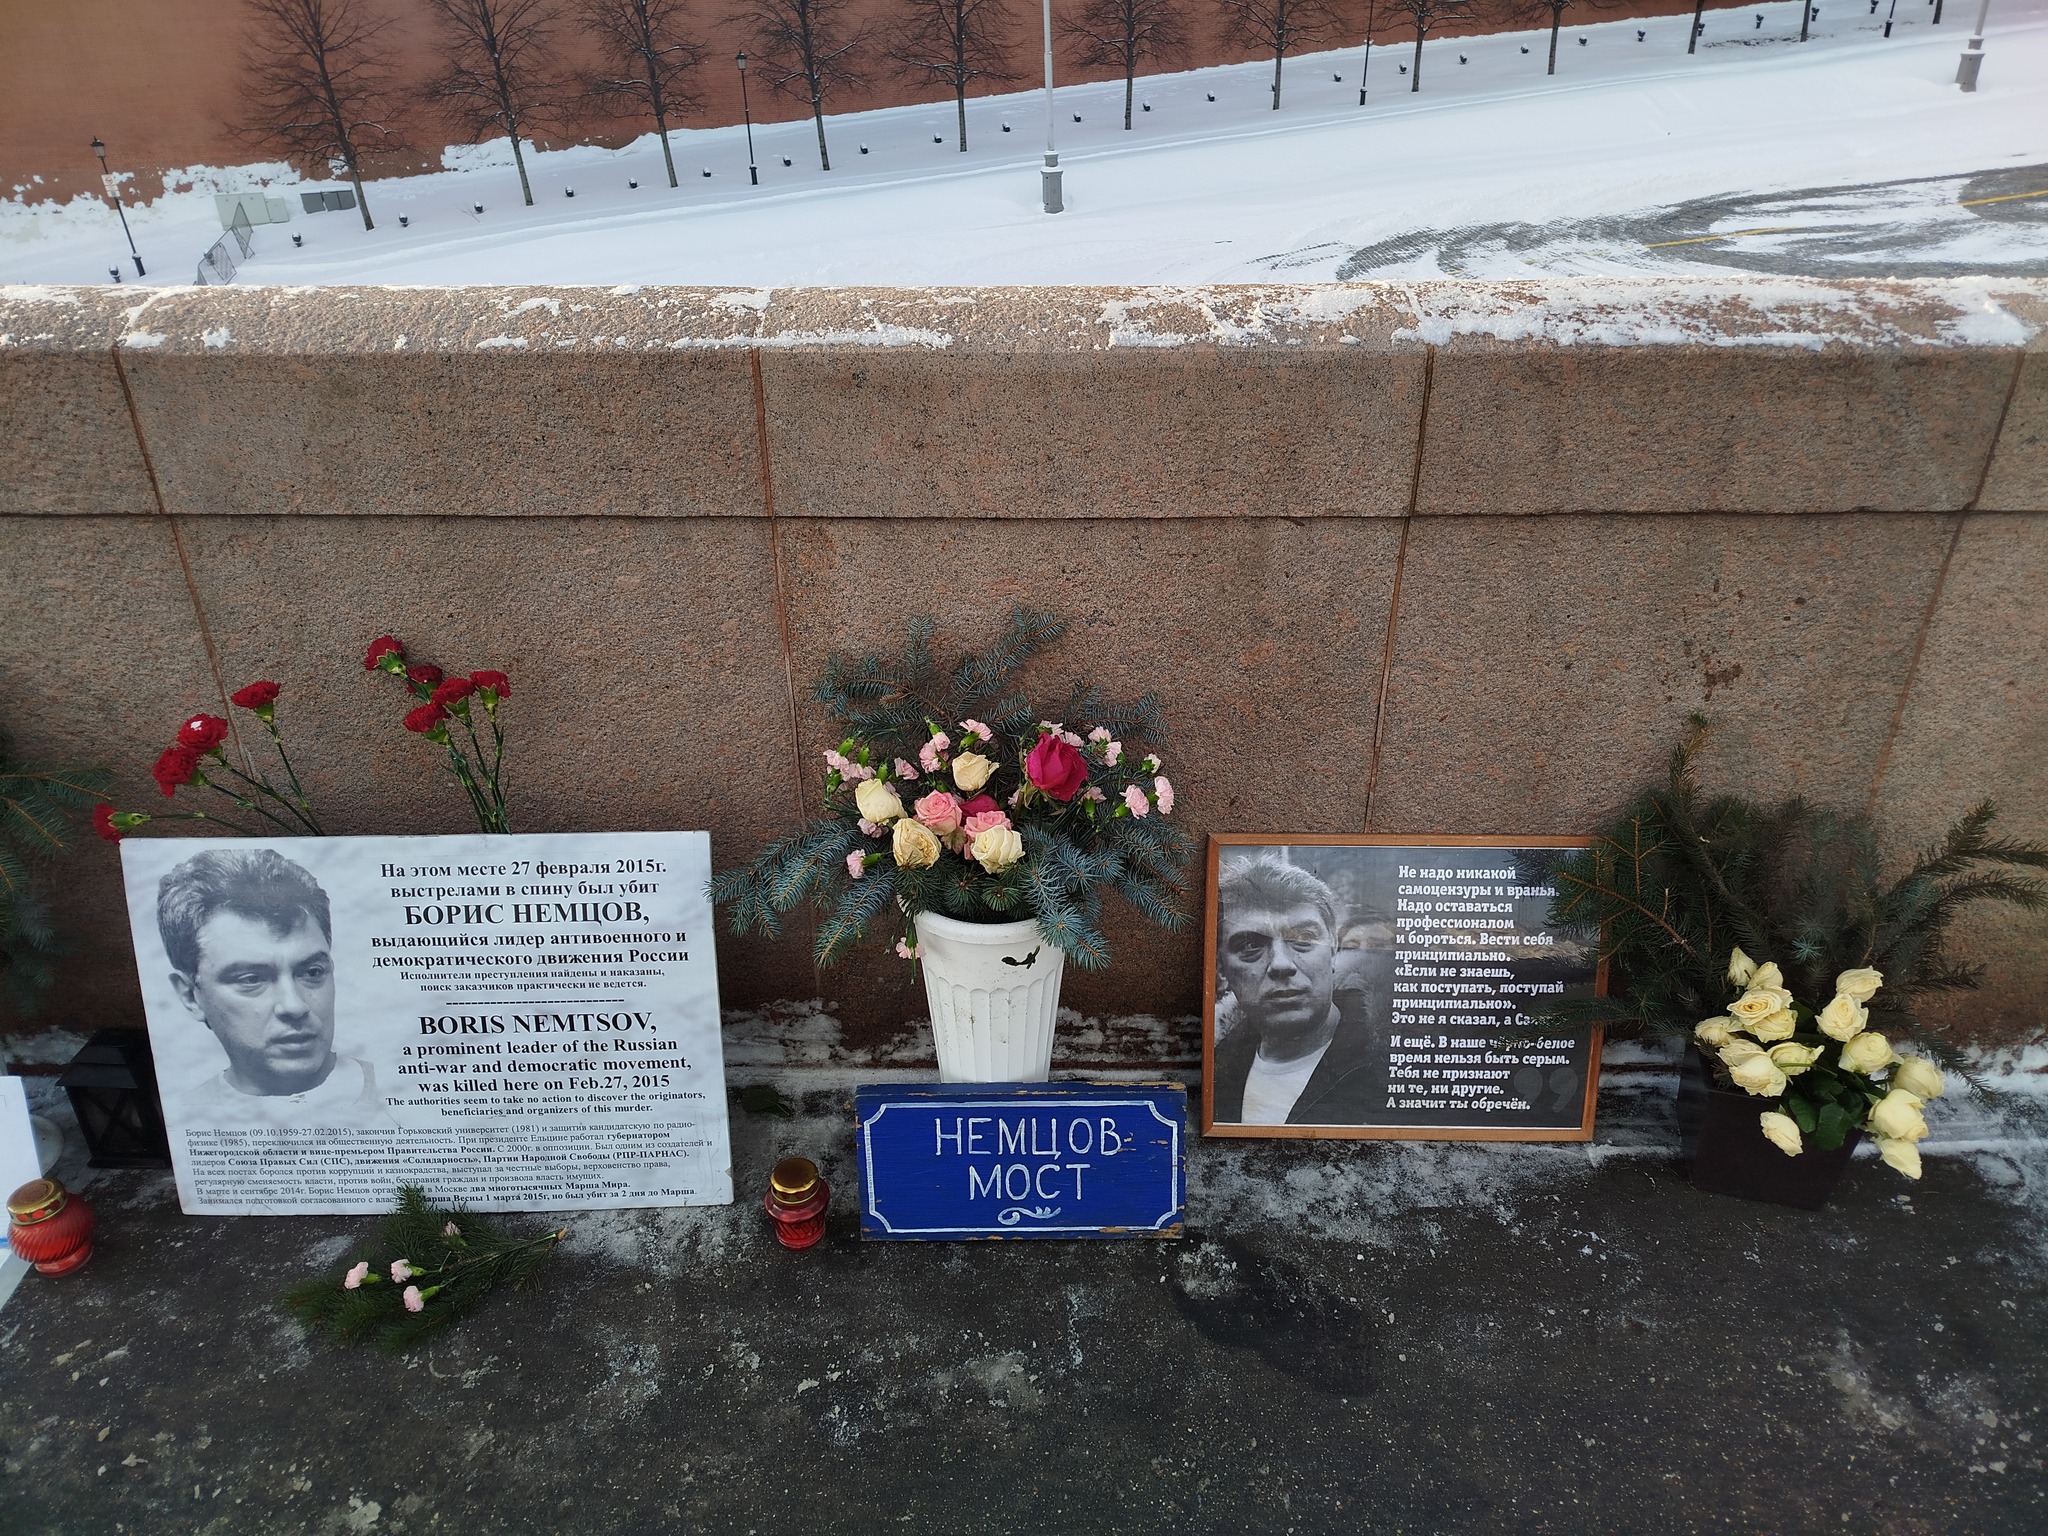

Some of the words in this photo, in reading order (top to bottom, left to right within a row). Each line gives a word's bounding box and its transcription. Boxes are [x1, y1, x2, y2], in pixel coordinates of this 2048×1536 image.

[381, 864, 406, 877] На
[411, 867, 451, 877] этом
[458, 865, 506, 876] месте
[511, 861, 530, 875] 27
[536, 861, 610, 878] февраля
[616, 859, 666, 873] 2015г.
[1398, 865, 1416, 878] Не
[1419, 869, 1453, 881] надо
[1456, 866, 1516, 879] никакой
[391, 886, 500, 901] выстрелами
[506, 886, 515, 895] в
[521, 885, 573, 898] спину
[578, 881, 613, 894] был
[619, 880, 659, 898] убит
[1398, 885, 1491, 899] самоцензуры
[1494, 886, 1503, 896] и
[404, 904, 504, 925] БОРИС
[513, 902, 649, 926] НЕМЦОВ,
[1397, 899, 1432, 915] Надо
[1435, 902, 1513, 912] оставаться
[1396, 916, 1514, 931] профессионалом
[371, 933, 489, 948] выдающийся
[494, 935, 545, 948] лидер
[551, 933, 671, 944] антивоенного
[676, 932, 686, 942] и
[1396, 934, 1405, 944] и
[1408, 931, 1476, 947] бороться.
[1479, 933, 1520, 945] Вести
[1523, 932, 1553, 945] себя
[372, 955, 532, 970] демократического
[537, 953, 623, 966] движения
[629, 949, 688, 962] России
[1395, 951, 1511, 963] принципиально.
[400, 972, 471, 980] Исполнители
[474, 972, 548, 981] преступления
[551, 969, 597, 978] найдены
[1394, 964, 1437, 977] «Если
[1439, 967, 1456, 977] не
[1460, 968, 1515, 980] знаешь,
[517, 982, 586, 992] практически
[1393, 982, 1418, 993] как
[1421, 983, 1496, 996] поступать,
[1499, 979, 1564, 996] поступай
[1392, 999, 1516, 1011] принципиально».
[418, 1015, 505, 1035] BORIS
[512, 1012, 656, 1034] NEMTSOV,
[1392, 1012, 1415, 1024] Это
[1419, 1013, 1435, 1025] не
[1438, 1013, 1446, 1025] я
[1450, 1015, 1500, 1027] сказал,
[1504, 1014, 1511, 1025] а
[403, 1047, 412, 1055] a
[417, 1042, 501, 1059] prominent
[507, 1041, 558, 1054] leader
[563, 1040, 579, 1052] of
[583, 1040, 608, 1052] the
[614, 1038, 677, 1051] Russian
[1390, 1035, 1401, 1047] И
[1403, 1035, 1435, 1050] ещё.
[1438, 1036, 1447, 1048] В
[1450, 1039, 1486, 1048] наше
[398, 1061, 467, 1074] anti-war
[472, 1060, 502, 1073] and
[508, 1058, 597, 1073] democratic
[603, 1057, 691, 1070] movement,
[1389, 1054, 1431, 1067] время
[1434, 1054, 1481, 1064] нельзя
[1485, 1051, 1519, 1064] быть
[1523, 1055, 1570, 1067] серым.
[1389, 1066, 1420, 1078] Тебя
[1423, 1069, 1439, 1078] не
[1442, 1070, 1510, 1081] признают
[418, 1083, 449, 1092] was
[453, 1079, 498, 1092] killed
[503, 1078, 539, 1091] here
[544, 1081, 563, 1090] on
[569, 1076, 627, 1091] Feb.27,
[632, 1075, 669, 1089] 2015
[1387, 1084, 1405, 1094] ни
[1408, 1084, 1428, 1096] те,
[1431, 1085, 1449, 1094] ни
[1451, 1085, 1504, 1098] другие.
[408, 1097, 460, 1105] authorities
[503, 1095, 524, 1104] take
[542, 1095, 572, 1103] action
[587, 1094, 628, 1102] discover
[631, 1093, 646, 1101] the
[649, 1092, 706, 1101] originators,
[1386, 1097, 1396, 1108] А
[1399, 1099, 1447, 1108] значит
[1449, 1100, 1468, 1108] ты
[1471, 1097, 1530, 1112] обречён.
[441, 1107, 503, 1116] beneficiaries
[505, 1106, 524, 1115] and
[527, 1106, 578, 1116] organizers
[581, 1105, 591, 1113] of
[594, 1104, 611, 1113] this
[615, 1104, 653, 1112] murder.
[186, 1129, 211, 1139] Борис
[213, 1129, 247, 1139] Немцов
[398, 1125, 453, 1136] Горьковский
[455, 1127, 509, 1135] университет
[512, 1125, 539, 1134] (1981)
[549, 1123, 587, 1132] защитив
[589, 1123, 651, 1131] кандидатскую
[667, 1122, 695, 1130] радио-
[934, 1117, 1122, 1160] НЕМЦОВ
[189, 1149, 260, 1158] Нижегородской
[262, 1147, 298, 1155] области
[309, 1146, 385, 1156] вице-премьером
[387, 1147, 458, 1155] Правительства
[461, 1143, 495, 1152] России.
[542, 1143, 592, 1152] оппозиции.
[657, 1140, 704, 1150] создателей
[260, 1158, 297, 1167] Правых
[320, 1155, 353, 1166] (СПС),
[355, 1156, 400, 1165] движения
[483, 1155, 519, 1163] Партии
[521, 1154, 567, 1163] Народной
[969, 1163, 1091, 1201] МОСТ
